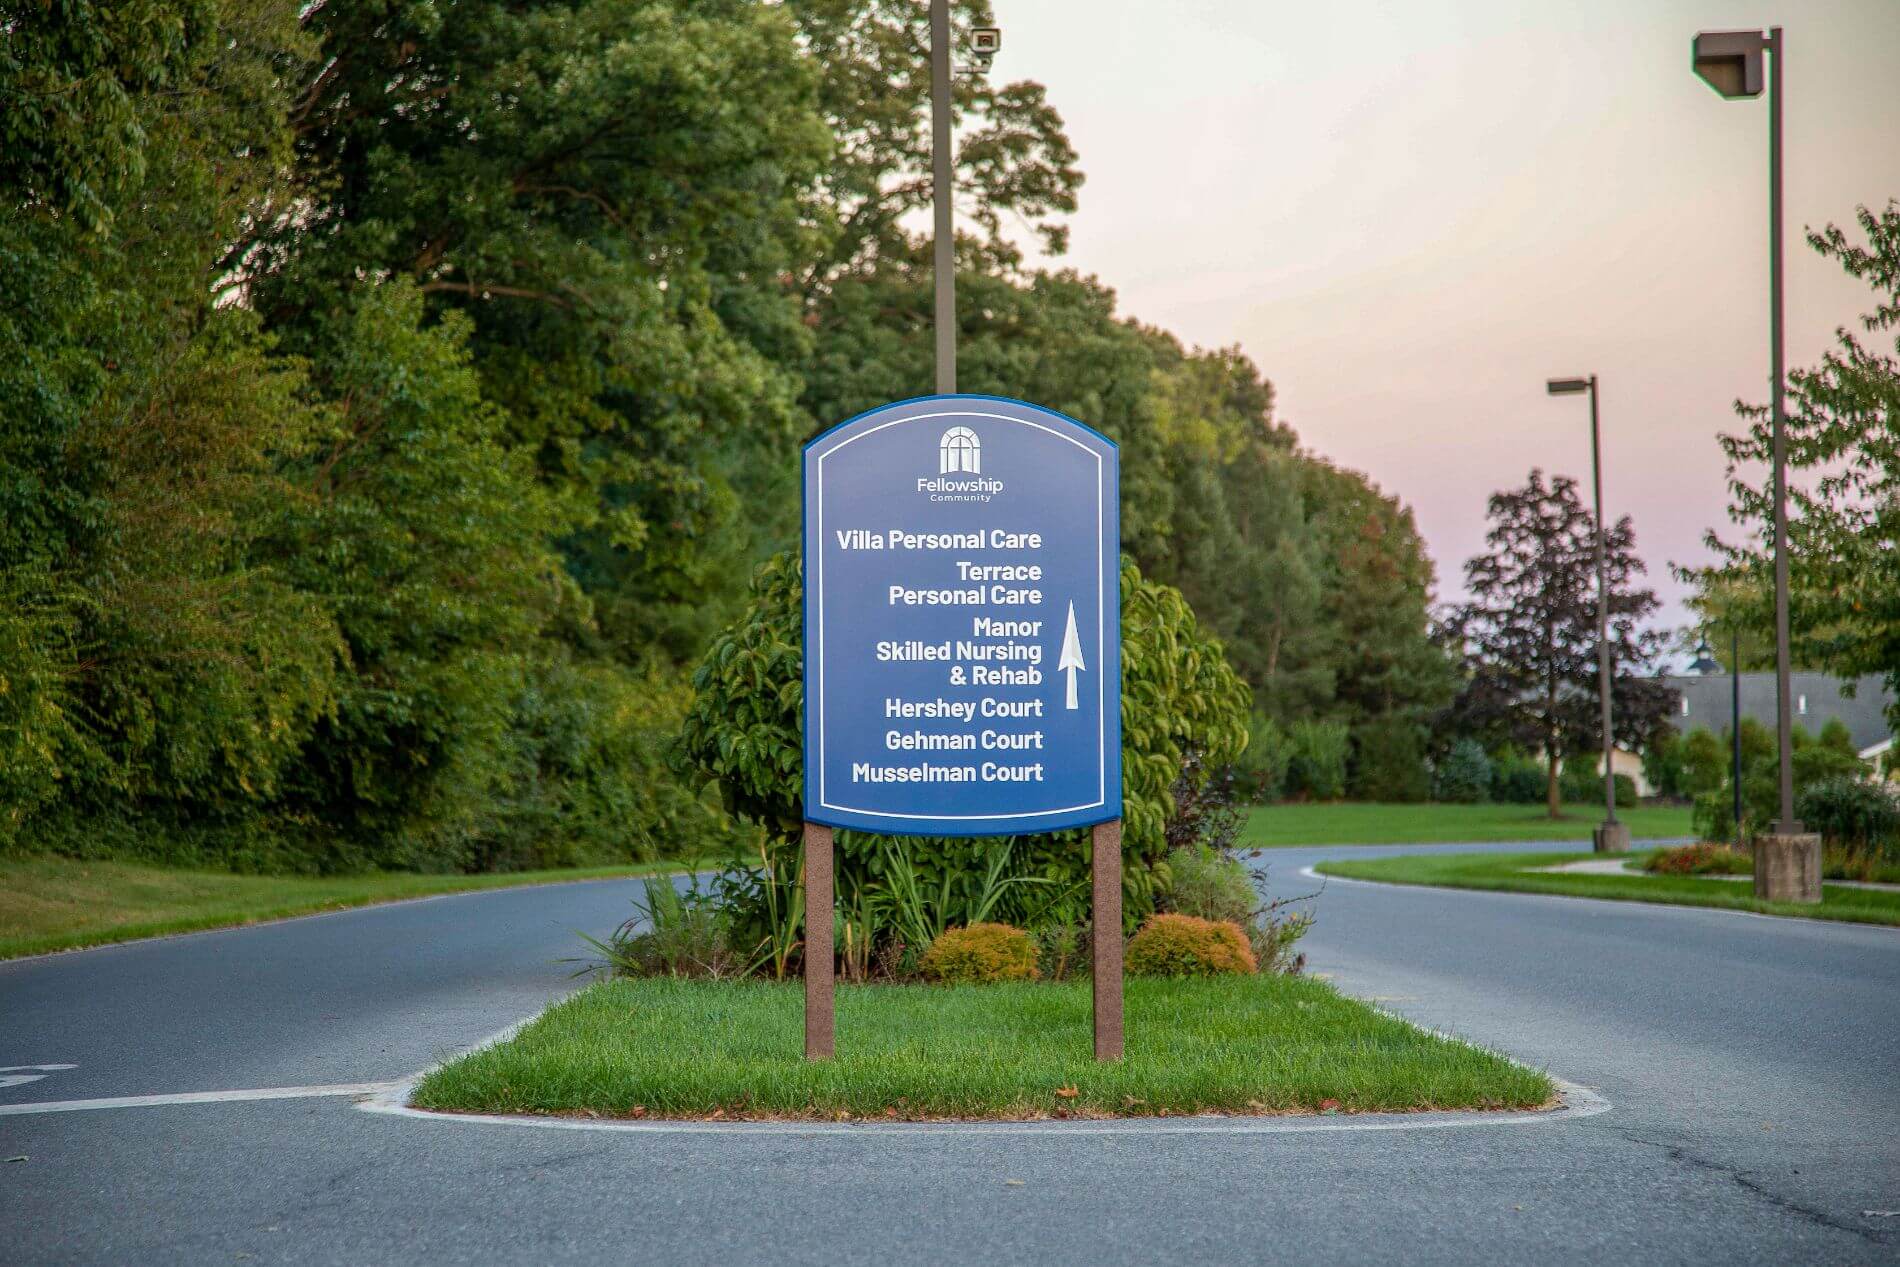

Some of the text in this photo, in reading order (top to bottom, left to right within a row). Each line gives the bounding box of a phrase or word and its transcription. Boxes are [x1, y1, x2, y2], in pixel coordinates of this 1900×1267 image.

[917, 478, 1004, 495] Fellowship
[930, 493, 991, 502] Community
[837, 530, 1041, 549] Villa Personal Care
[957, 562, 1042, 580] Terrace
[890, 585, 1042, 605] Personal Care
[974, 617, 1042, 636] Manor
[877, 641, 1042, 664] Skilled Nursing
[950, 665, 1042, 685] & Rehab
[886, 698, 1043, 722] Hershey Court
[886, 730, 1043, 750] Gehman Court
[853, 762, 1043, 782] Musselman Court
